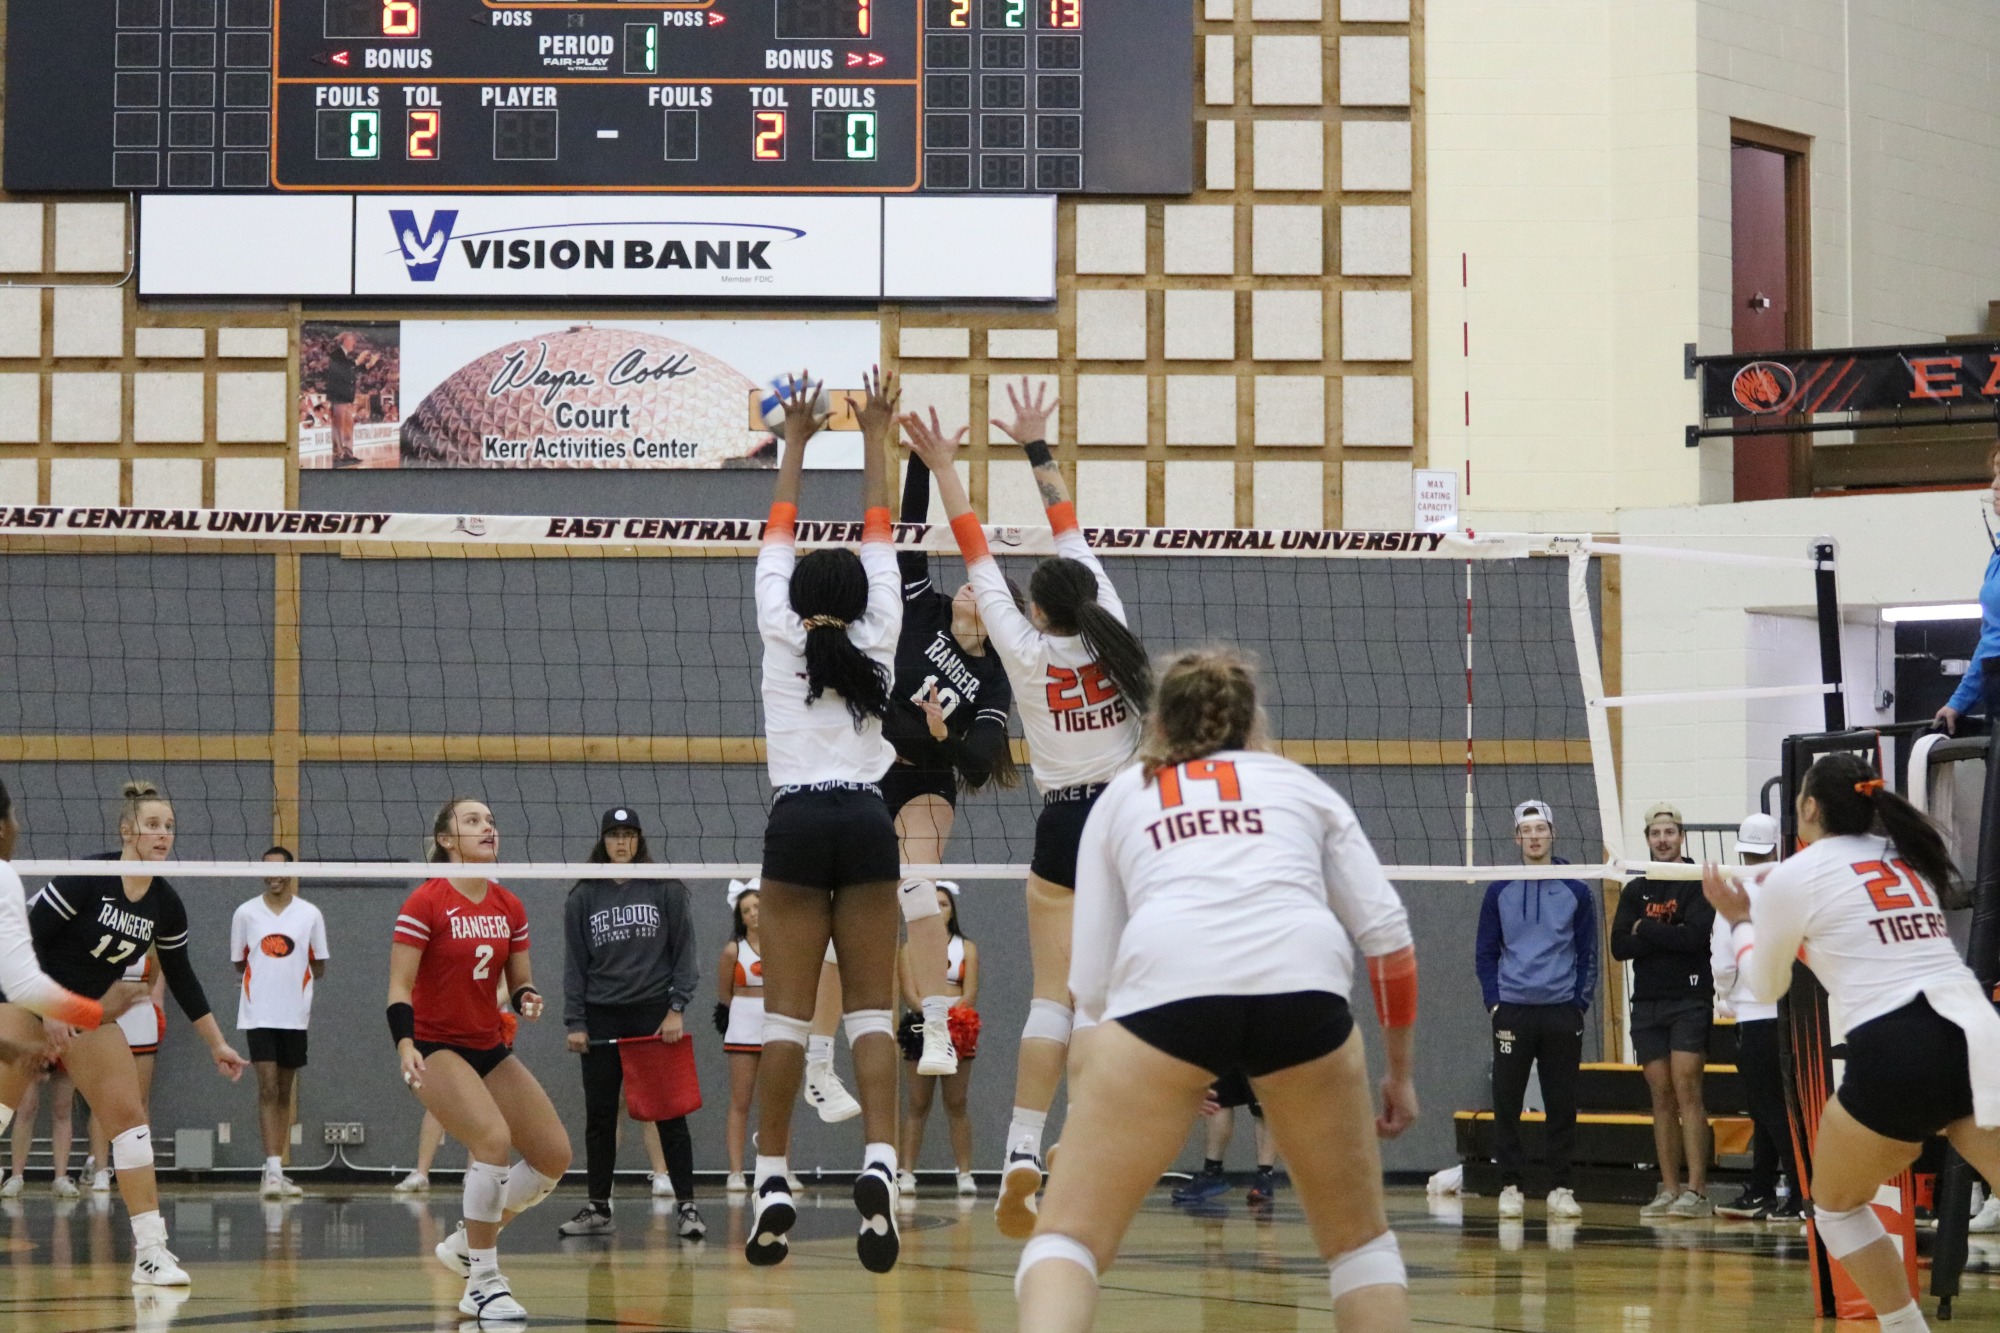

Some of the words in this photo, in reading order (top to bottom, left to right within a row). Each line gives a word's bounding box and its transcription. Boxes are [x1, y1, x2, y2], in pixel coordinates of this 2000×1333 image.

[492, 11, 533, 26] POSS
[663, 11, 704, 27] POSS
[538, 35, 615, 56] PERIOD
[645, 26, 655, 71] 1
[364, 48, 433, 69] BONUS
[543, 57, 609, 67] FAIR-PLAY
[765, 49, 833, 70] BONUS
[315, 86, 380, 107] FOULS
[402, 86, 442, 107] TOL
[481, 86, 557, 107] PLAYER
[648, 86, 713, 107] FOULS
[749, 87, 788, 107] TOL
[811, 87, 875, 108] FOULS
[350, 112, 378, 157] 0
[409, 112, 438, 157] 2
[755, 113, 784, 158] 2
[847, 113, 875, 158] 0
[461, 239, 614, 269] VISION
[624, 240, 773, 270] BANK
[721, 275, 752, 283] Member
[754, 275, 774, 283] FDIC
[490, 342, 595, 406] Wayne
[608, 348, 697, 386] Cobb
[555, 402, 630, 429] Court
[485, 437, 527, 458] Kerr
[533, 437, 626, 458] Activities
[633, 437, 698, 458] Center
[1420, 491, 1451, 500] SEATING
[1427, 480, 1444, 489] MAX
[1417, 502, 1452, 511] CAPACITY
[66, 508, 201, 531] CENTRAL
[207, 511, 392, 534] UNIVERSITY
[545, 517, 620, 538] EAST
[623, 519, 753, 541] CENTRAL
[1152, 529, 1275, 550] CENTRAL
[1280, 530, 1446, 552] UNIVERSITY
[1049, 699, 1127, 733] TIGERS
[1144, 808, 1264, 851] TIGERS
[1850, 857, 1933, 912] 21
[97, 902, 155, 941] RANGERS
[451, 915, 511, 939] RANGERS
[612, 905, 661, 928] LOUIS
[89, 933, 137, 965] 17
[472, 945, 494, 981] 2
[1689, 974, 1699, 986] 17
[1499, 1040, 1512, 1055] 26
